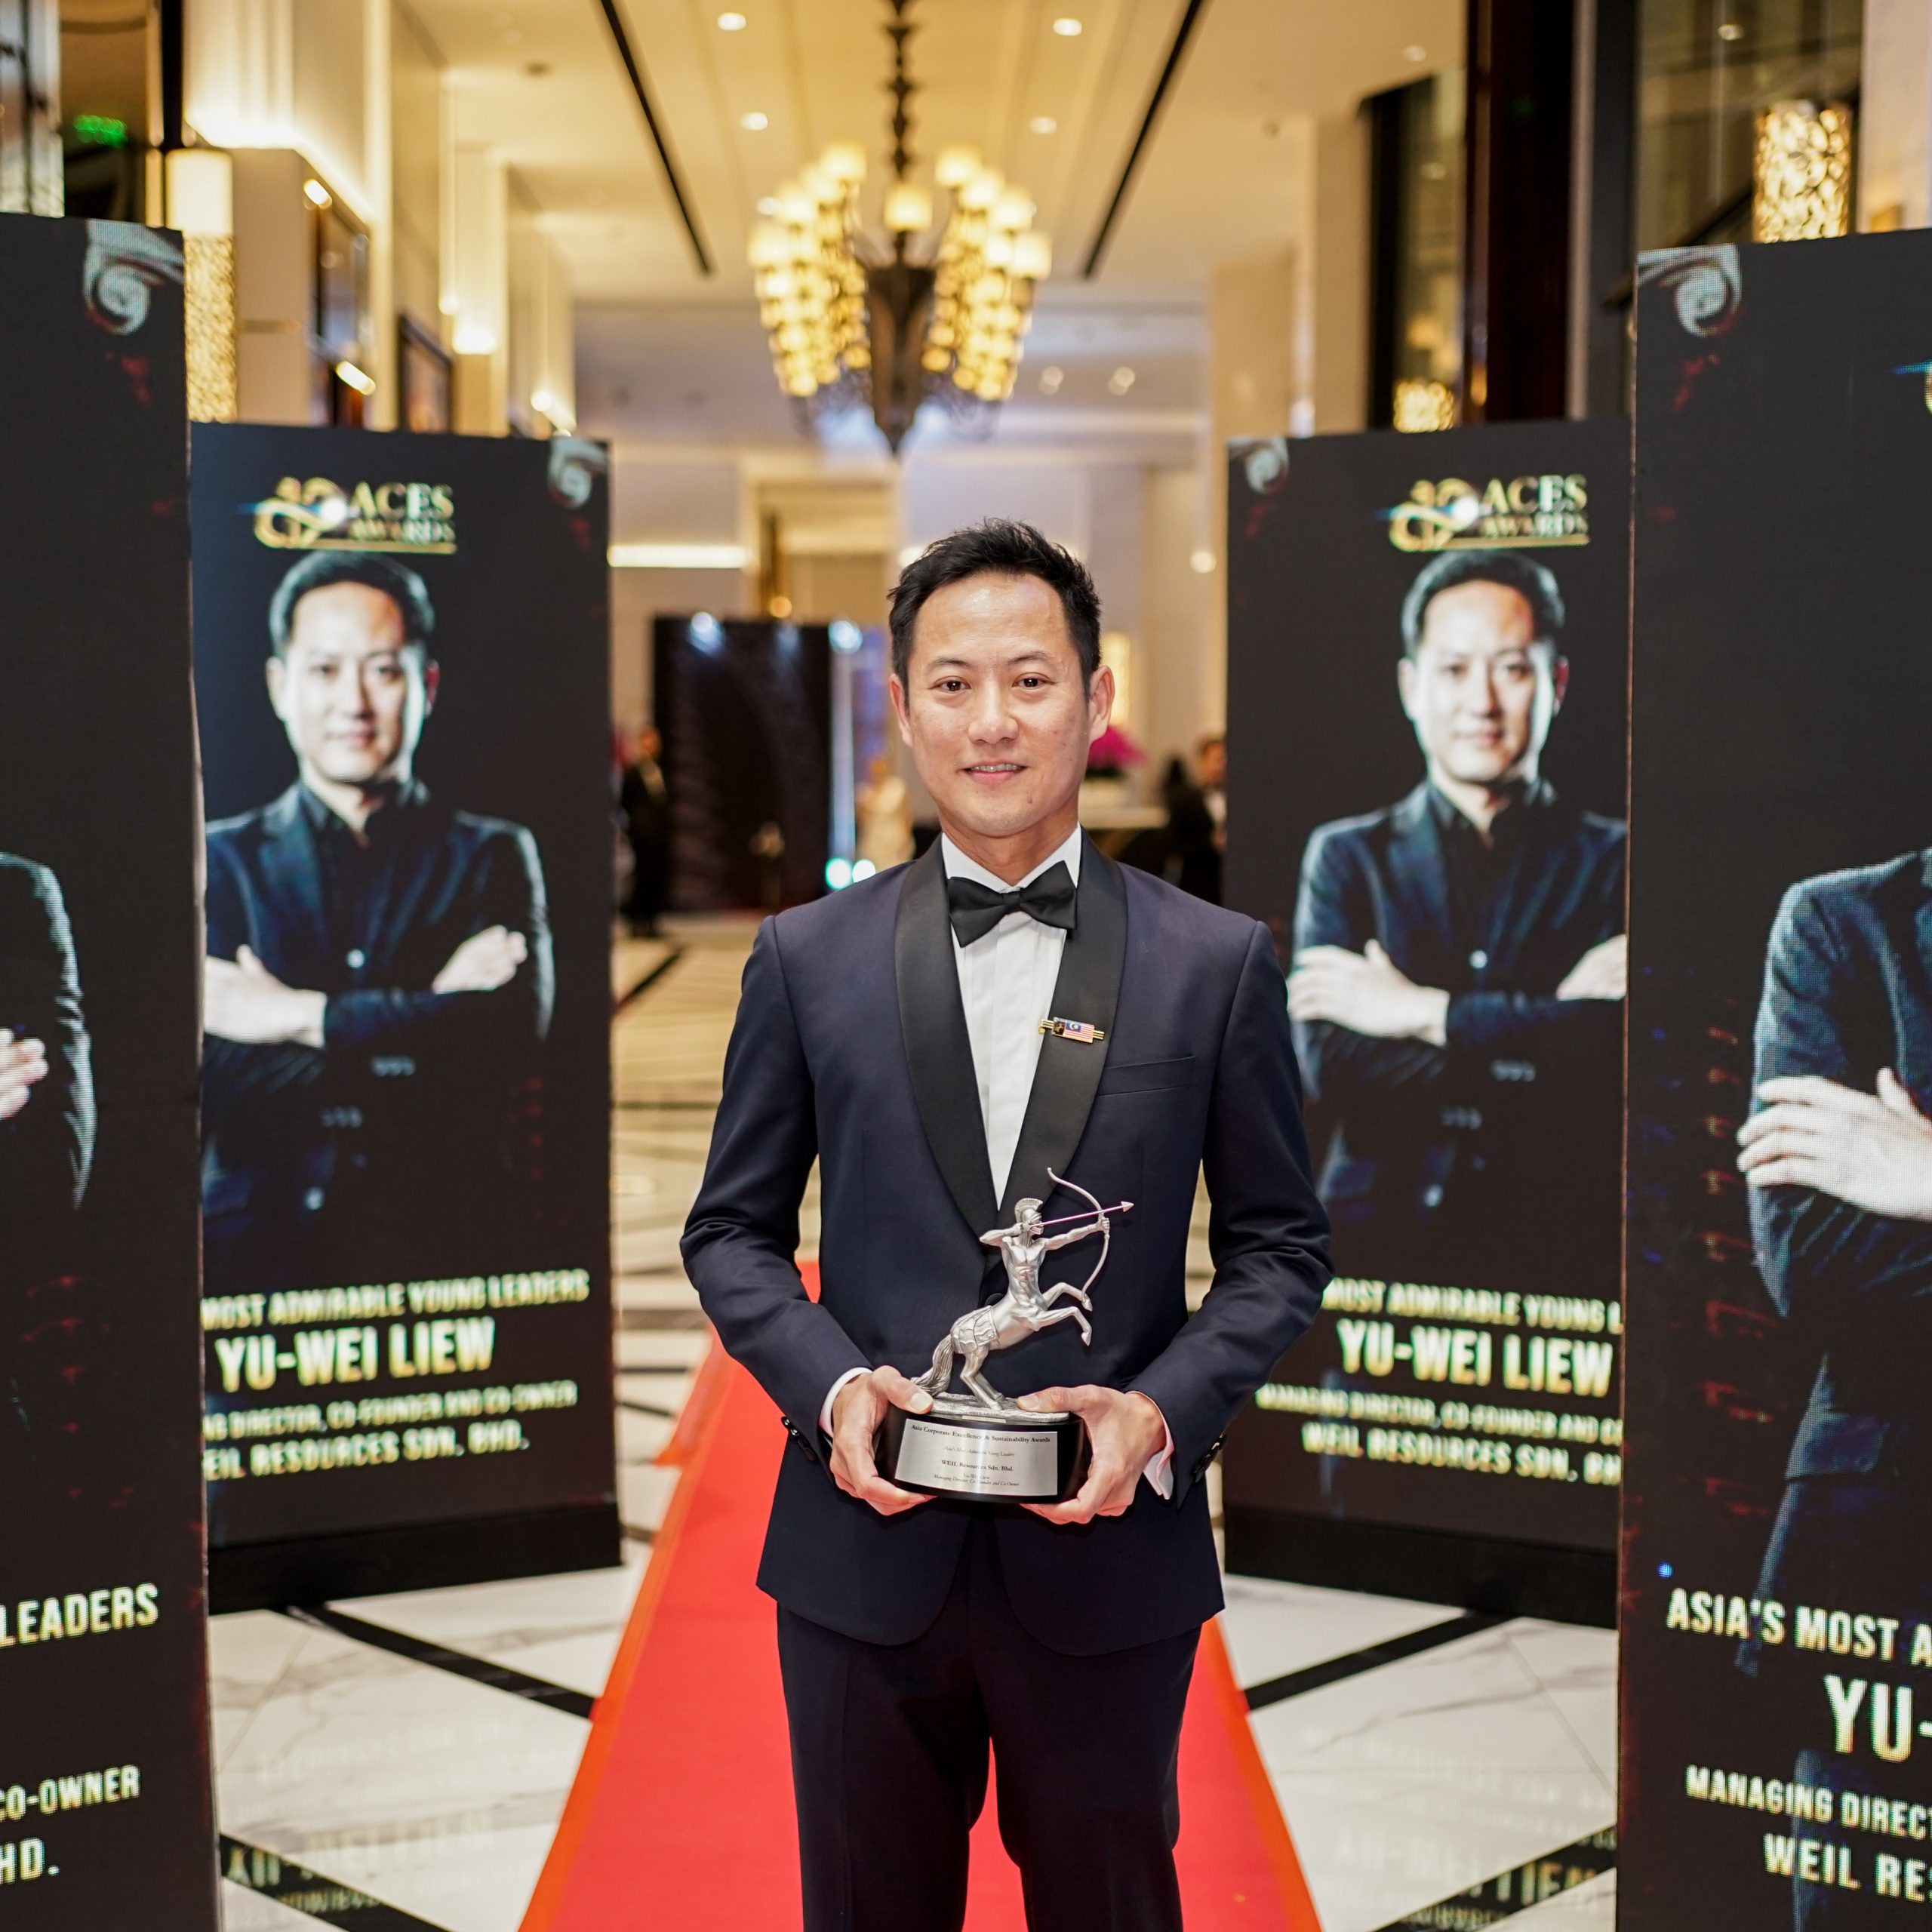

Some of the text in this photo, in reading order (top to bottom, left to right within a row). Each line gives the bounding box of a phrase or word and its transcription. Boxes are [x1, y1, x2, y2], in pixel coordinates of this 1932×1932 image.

[349, 481, 454, 520] ACES
[1481, 473, 1588, 515] ACES
[408, 1276, 486, 1314] YOUNG
[488, 1269, 589, 1308] LEADERS
[1523, 1294, 1605, 1333] YOUNG
[215, 1315, 496, 1392] YU-WEI LIEW
[1337, 1318, 1614, 1398] YU-WEI LIEW
[445, 1388, 483, 1418] AND
[1558, 1413, 1598, 1444] AND
[251, 1430, 399, 1476] RESOURCES
[467, 1419, 530, 1454] BHD.
[924, 1427, 951, 1435] Corporate
[992, 1435, 1029, 1444] Sustainability
[1302, 1421, 1364, 1458] WEIL
[1367, 1427, 1511, 1475] RESOURCES
[0, 1583, 158, 1648] LEADERS
[1666, 1588, 1932, 1669] ASIA'S MOST A
[1685, 1764, 1834, 1824] MANAGING
[1764, 1832, 1932, 1903] WEIL RE
